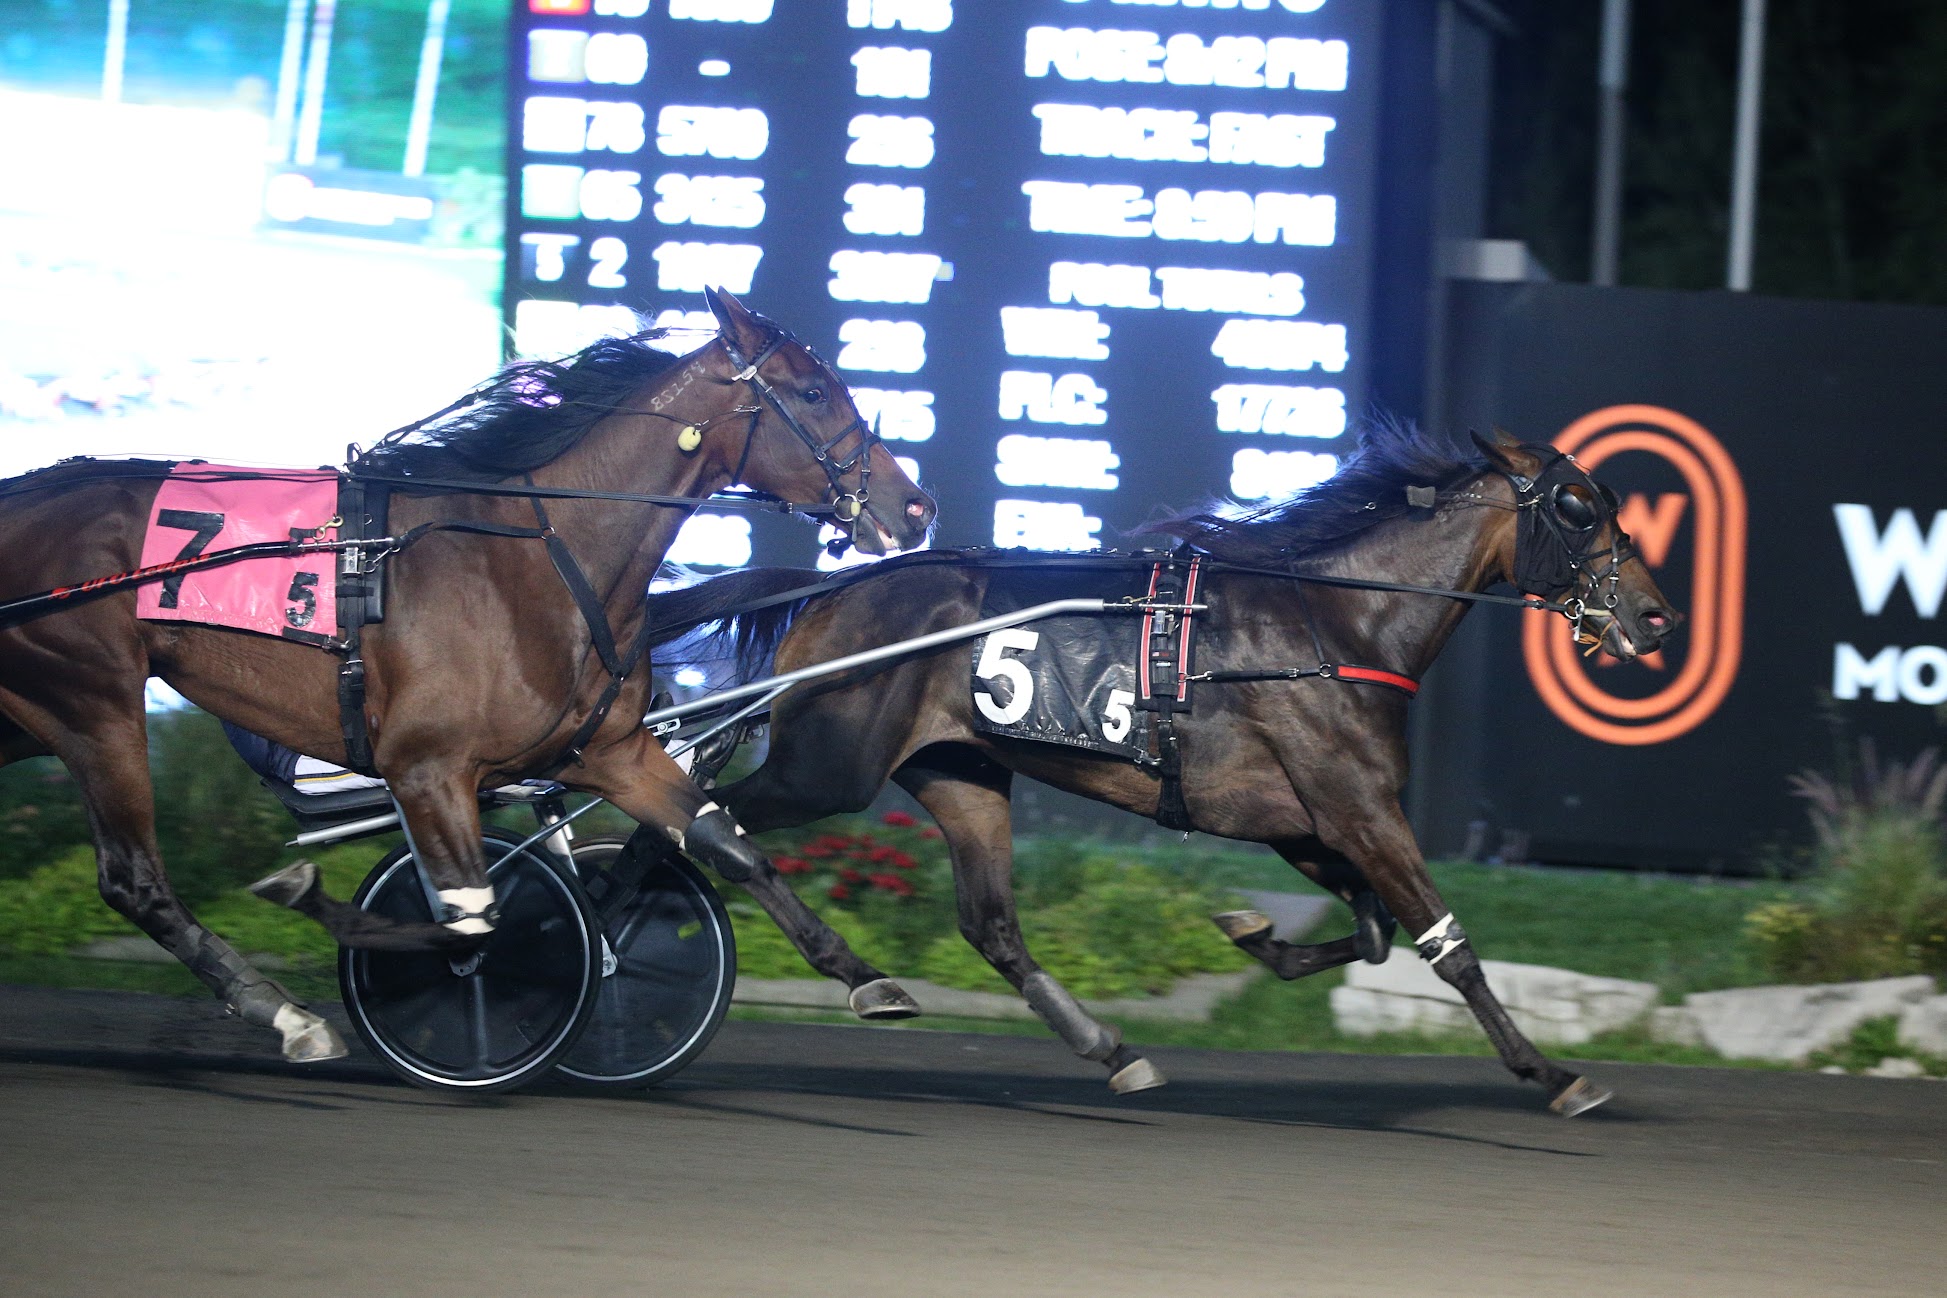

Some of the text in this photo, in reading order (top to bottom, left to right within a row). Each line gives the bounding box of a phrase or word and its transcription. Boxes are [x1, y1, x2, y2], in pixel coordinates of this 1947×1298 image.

[156, 508, 225, 609] 7
[285, 571, 320, 629] 5
[974, 628, 1039, 725] 5
[1832, 641, 1947, 706] MO
[1101, 688, 1135, 743] 5
